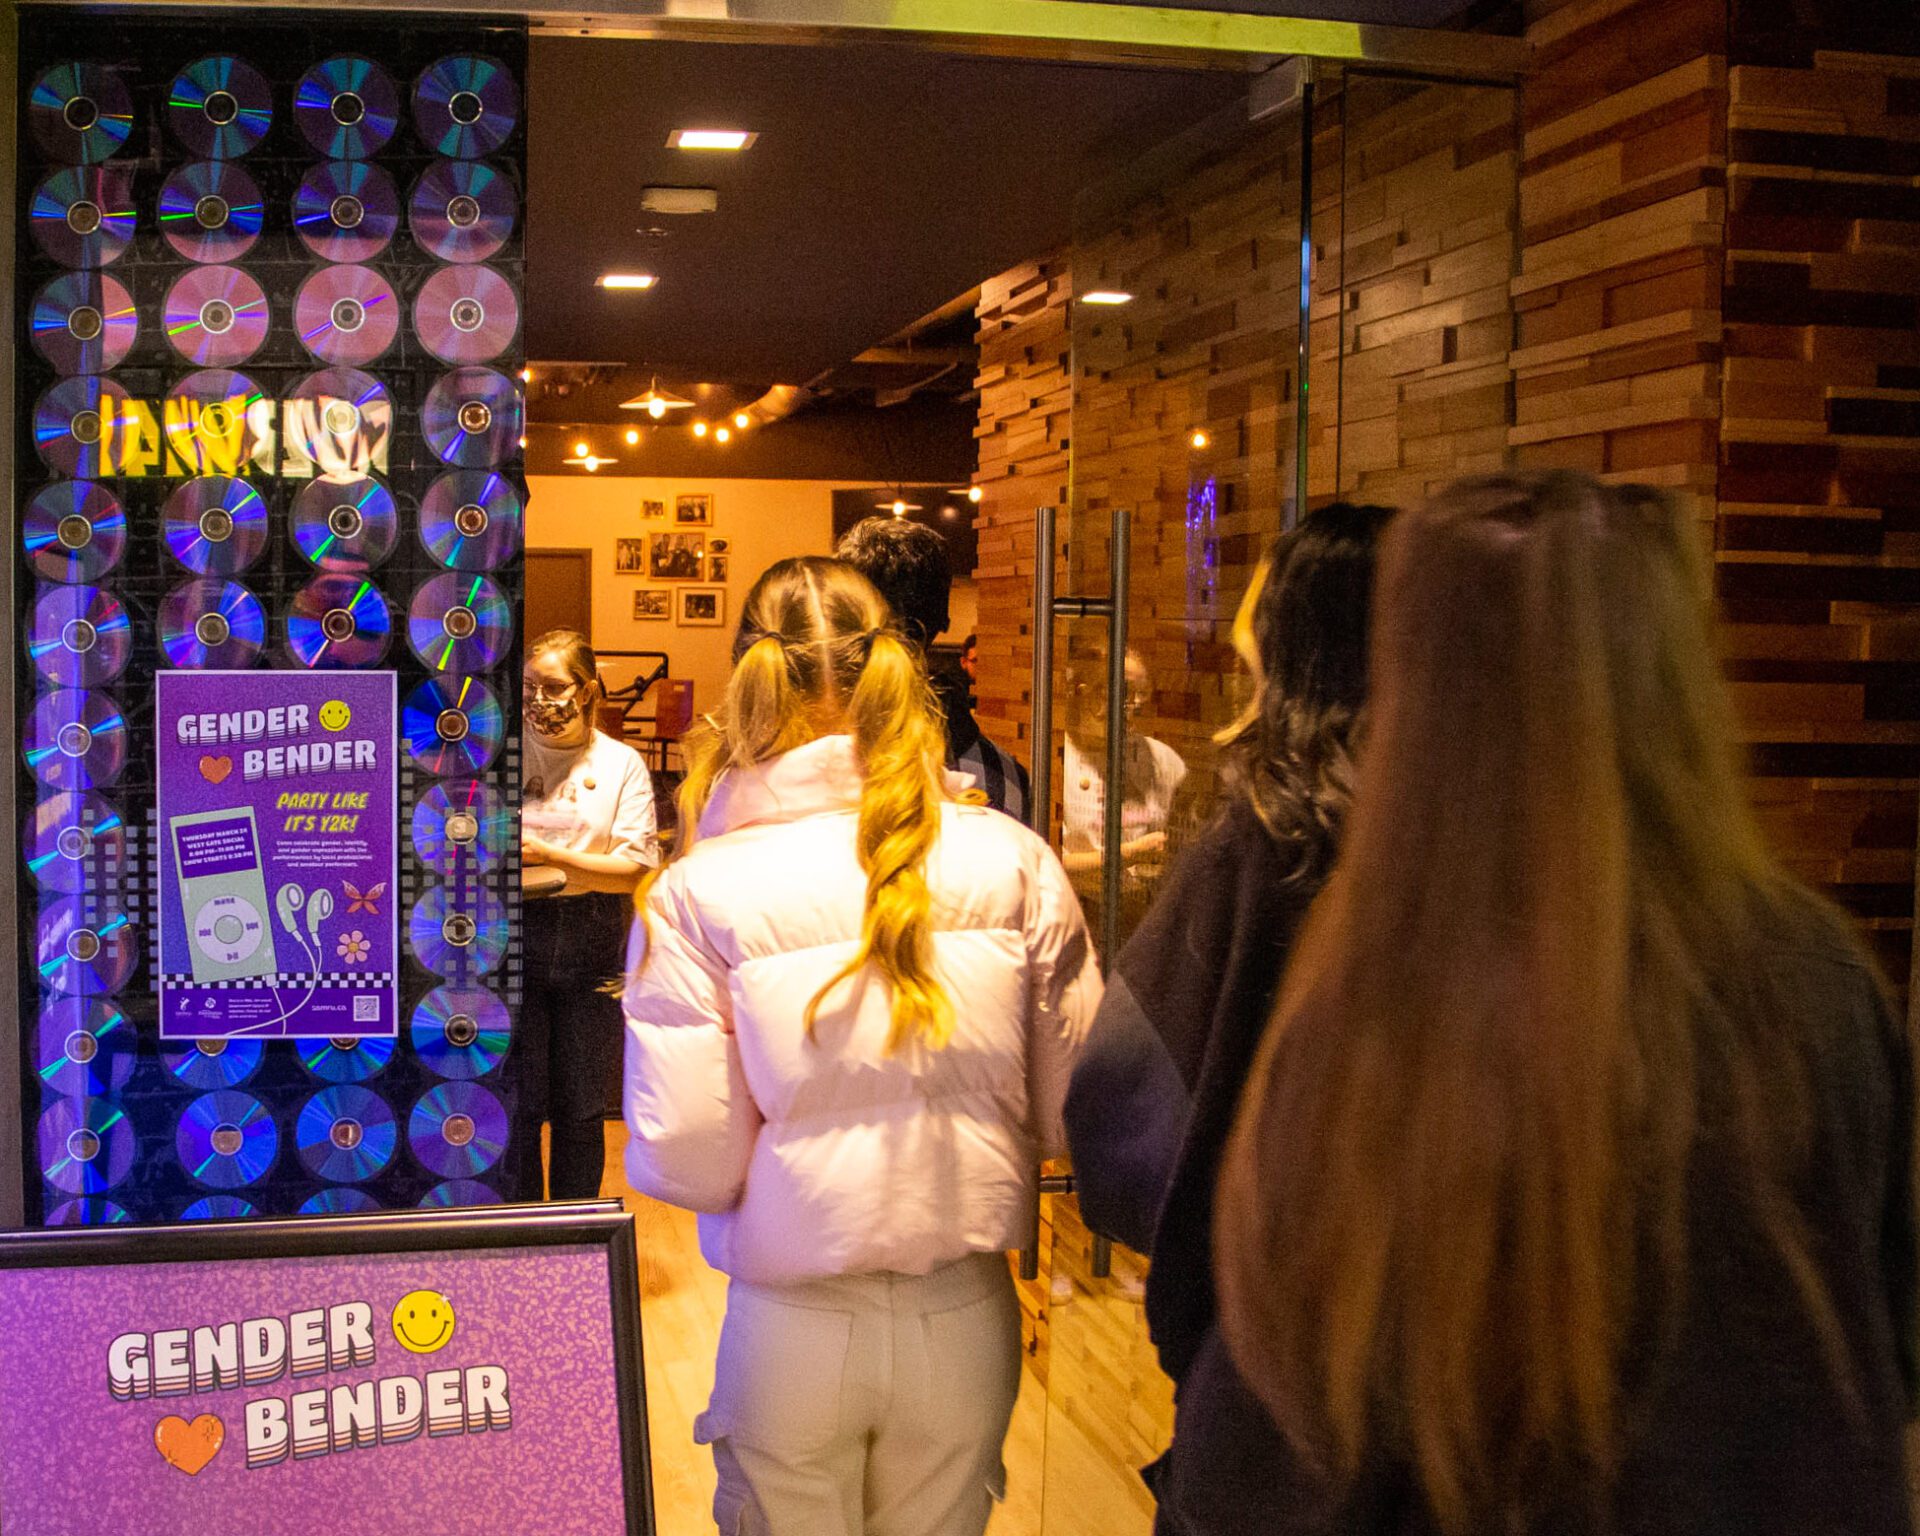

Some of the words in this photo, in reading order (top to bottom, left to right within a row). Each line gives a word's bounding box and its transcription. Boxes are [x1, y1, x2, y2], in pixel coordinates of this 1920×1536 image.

[177, 704, 309, 746] GENDER
[243, 739, 377, 783] BENDER
[276, 792, 329, 809] PARTY
[332, 792, 369, 809] LIKE
[321, 814, 359, 833] Y2K!
[182, 833, 215, 842] THURSDAY
[216, 829, 239, 837] MARCH
[204, 854, 228, 863] STARTS
[311, 1004, 348, 1012] samru.ca
[106, 1300, 377, 1401] GENDER
[244, 1364, 512, 1471] BENDER
